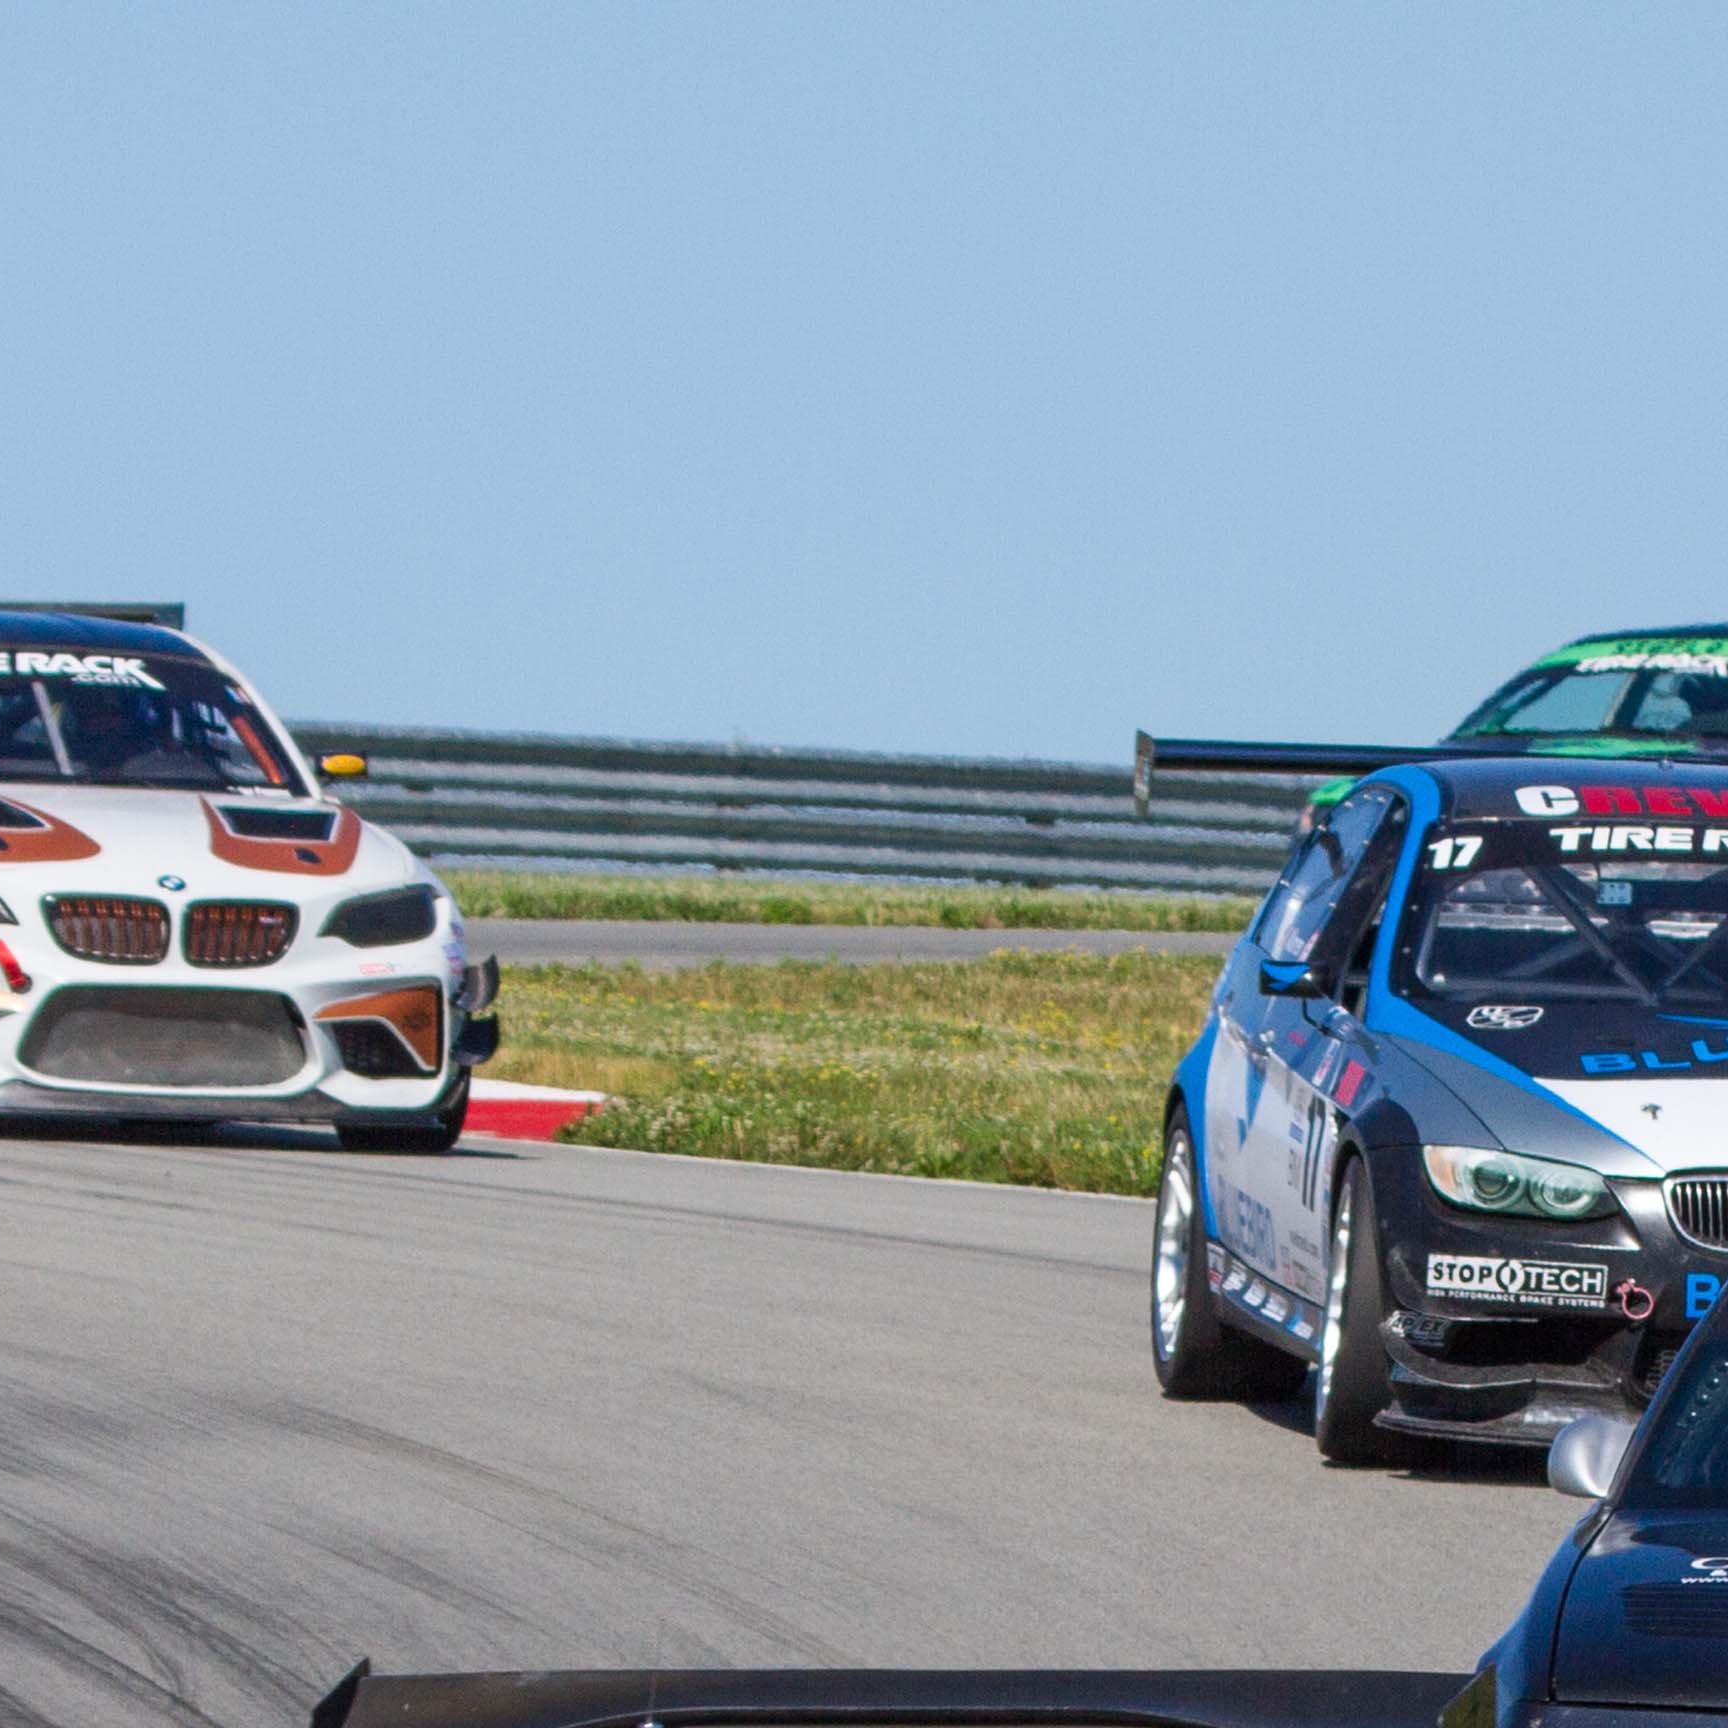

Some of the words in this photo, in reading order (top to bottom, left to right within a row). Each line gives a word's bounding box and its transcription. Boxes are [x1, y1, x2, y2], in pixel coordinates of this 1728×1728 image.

[14, 651, 167, 692] RACK
[1427, 836, 1484, 870] 17
[1548, 826, 1693, 852] TIRE
[1303, 1092, 1328, 1213] 17
[1447, 1290, 1516, 1304] PERFORMANCE
[1519, 1295, 1554, 1306] BRAKE
[1557, 1298, 1606, 1309] SYSTEMS
